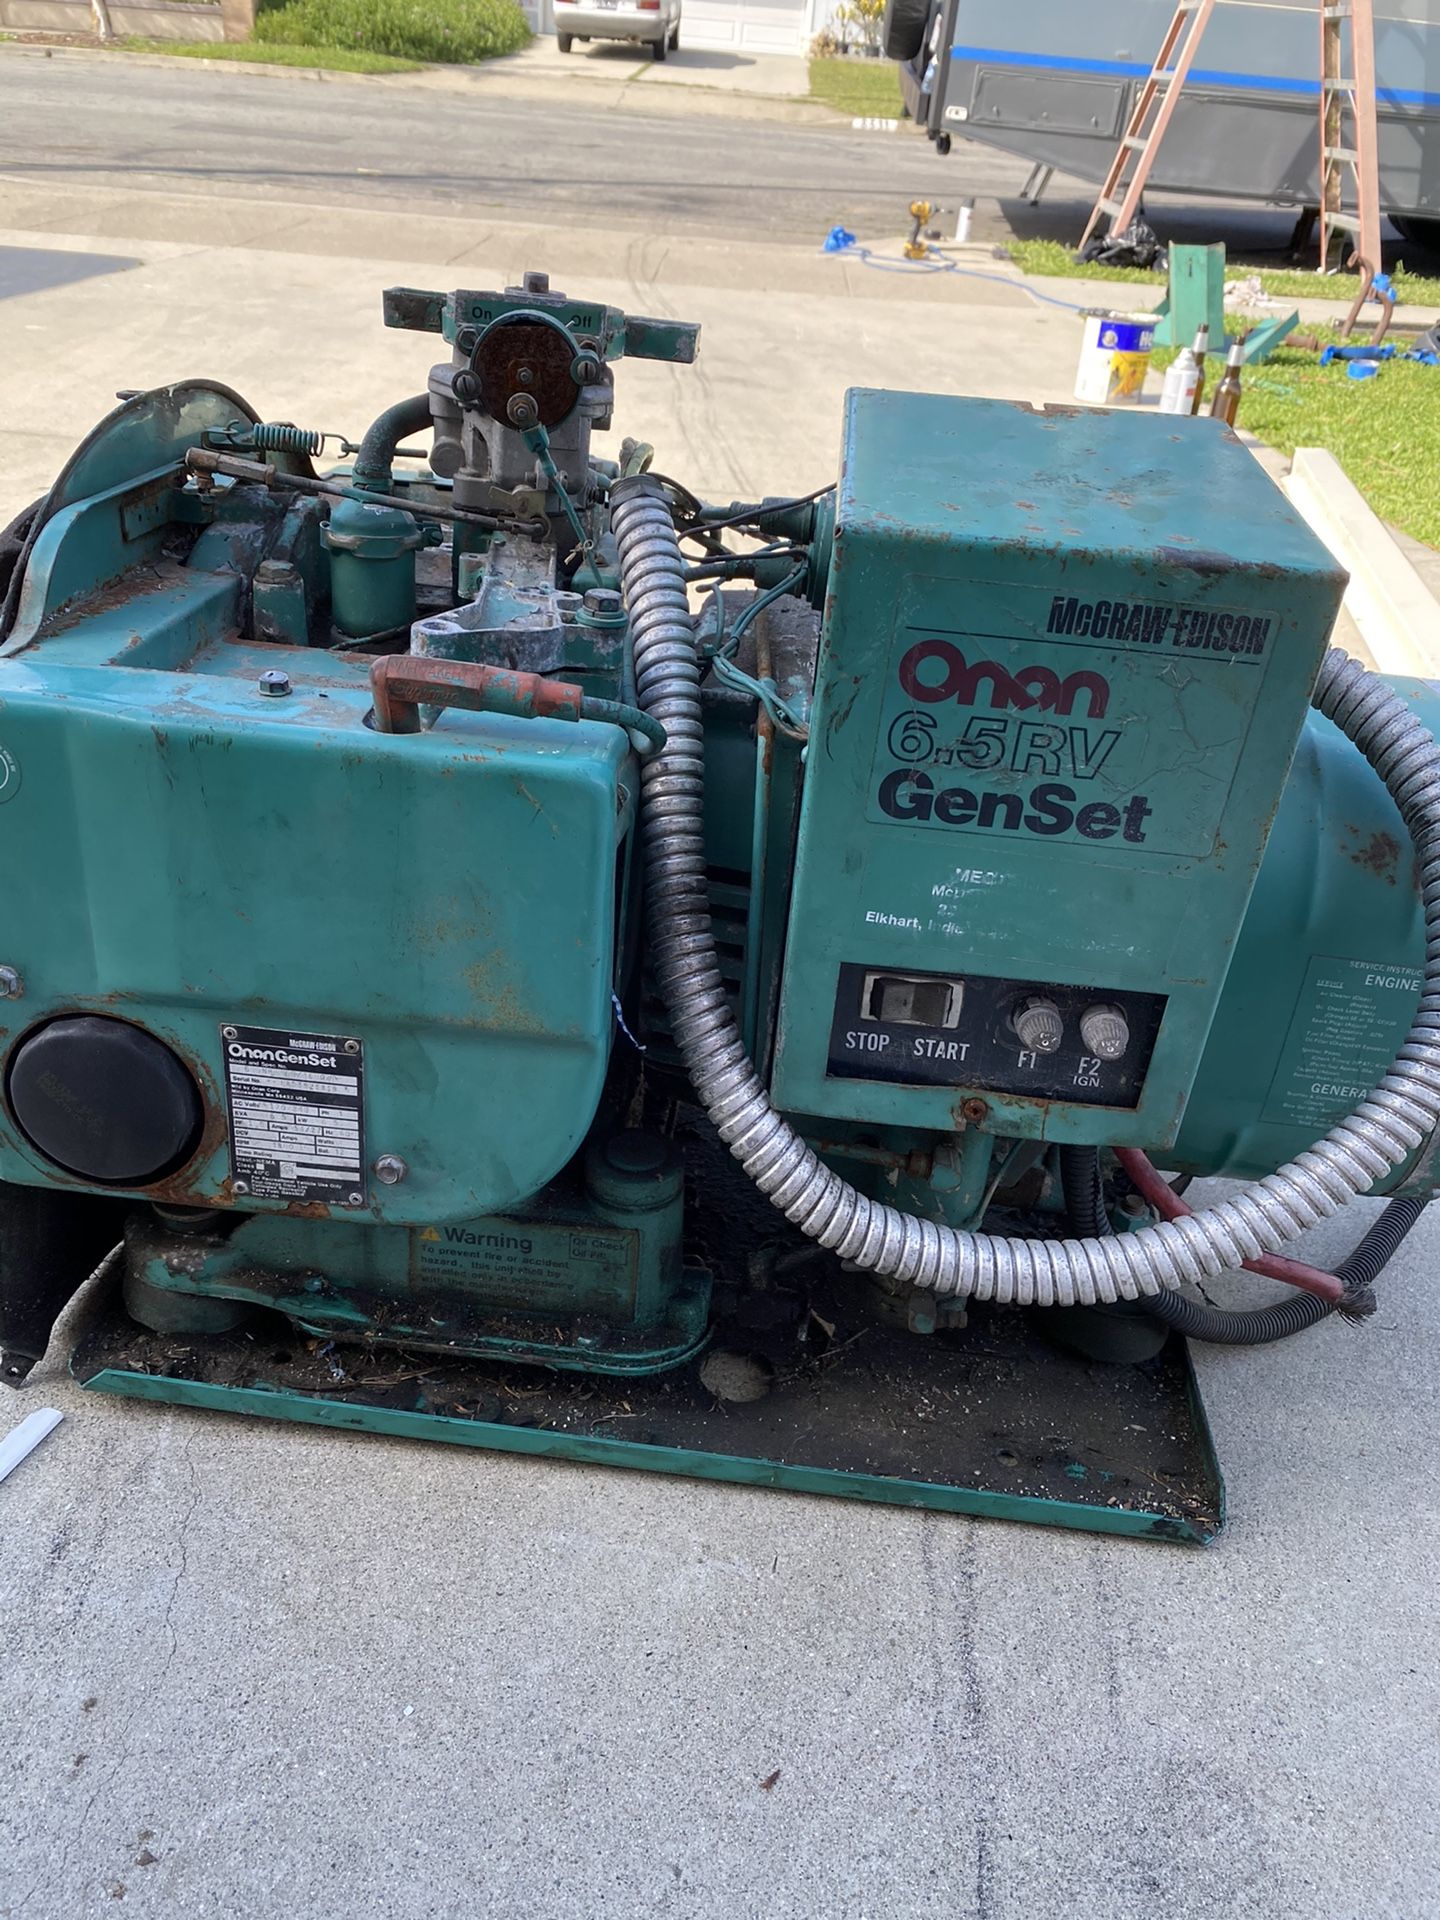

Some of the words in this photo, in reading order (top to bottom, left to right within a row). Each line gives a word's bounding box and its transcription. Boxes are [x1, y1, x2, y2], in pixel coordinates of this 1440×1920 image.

[471, 306, 492, 320] On
[571, 315, 592, 328] Off
[1047, 596, 1271, 655] McGRAW-EDISON
[899, 639, 1110, 719] Onan
[887, 710, 1123, 780] 6.5RV
[878, 768, 1153, 843] GenSet
[865, 911, 922, 932] Elkhart,
[1349, 960, 1385, 972] SERVICE
[1365, 974, 1421, 991] ENGINE
[845, 1031, 890, 1052] STOP
[914, 1038, 970, 1061] START
[1017, 1050, 1036, 1069] F1
[1078, 1057, 1102, 1076] F2
[1072, 1076, 1104, 1088] IGN.
[444, 1226, 533, 1254] Warning
[439, 1247, 480, 1260] prevent
[522, 1256, 570, 1269] accident
